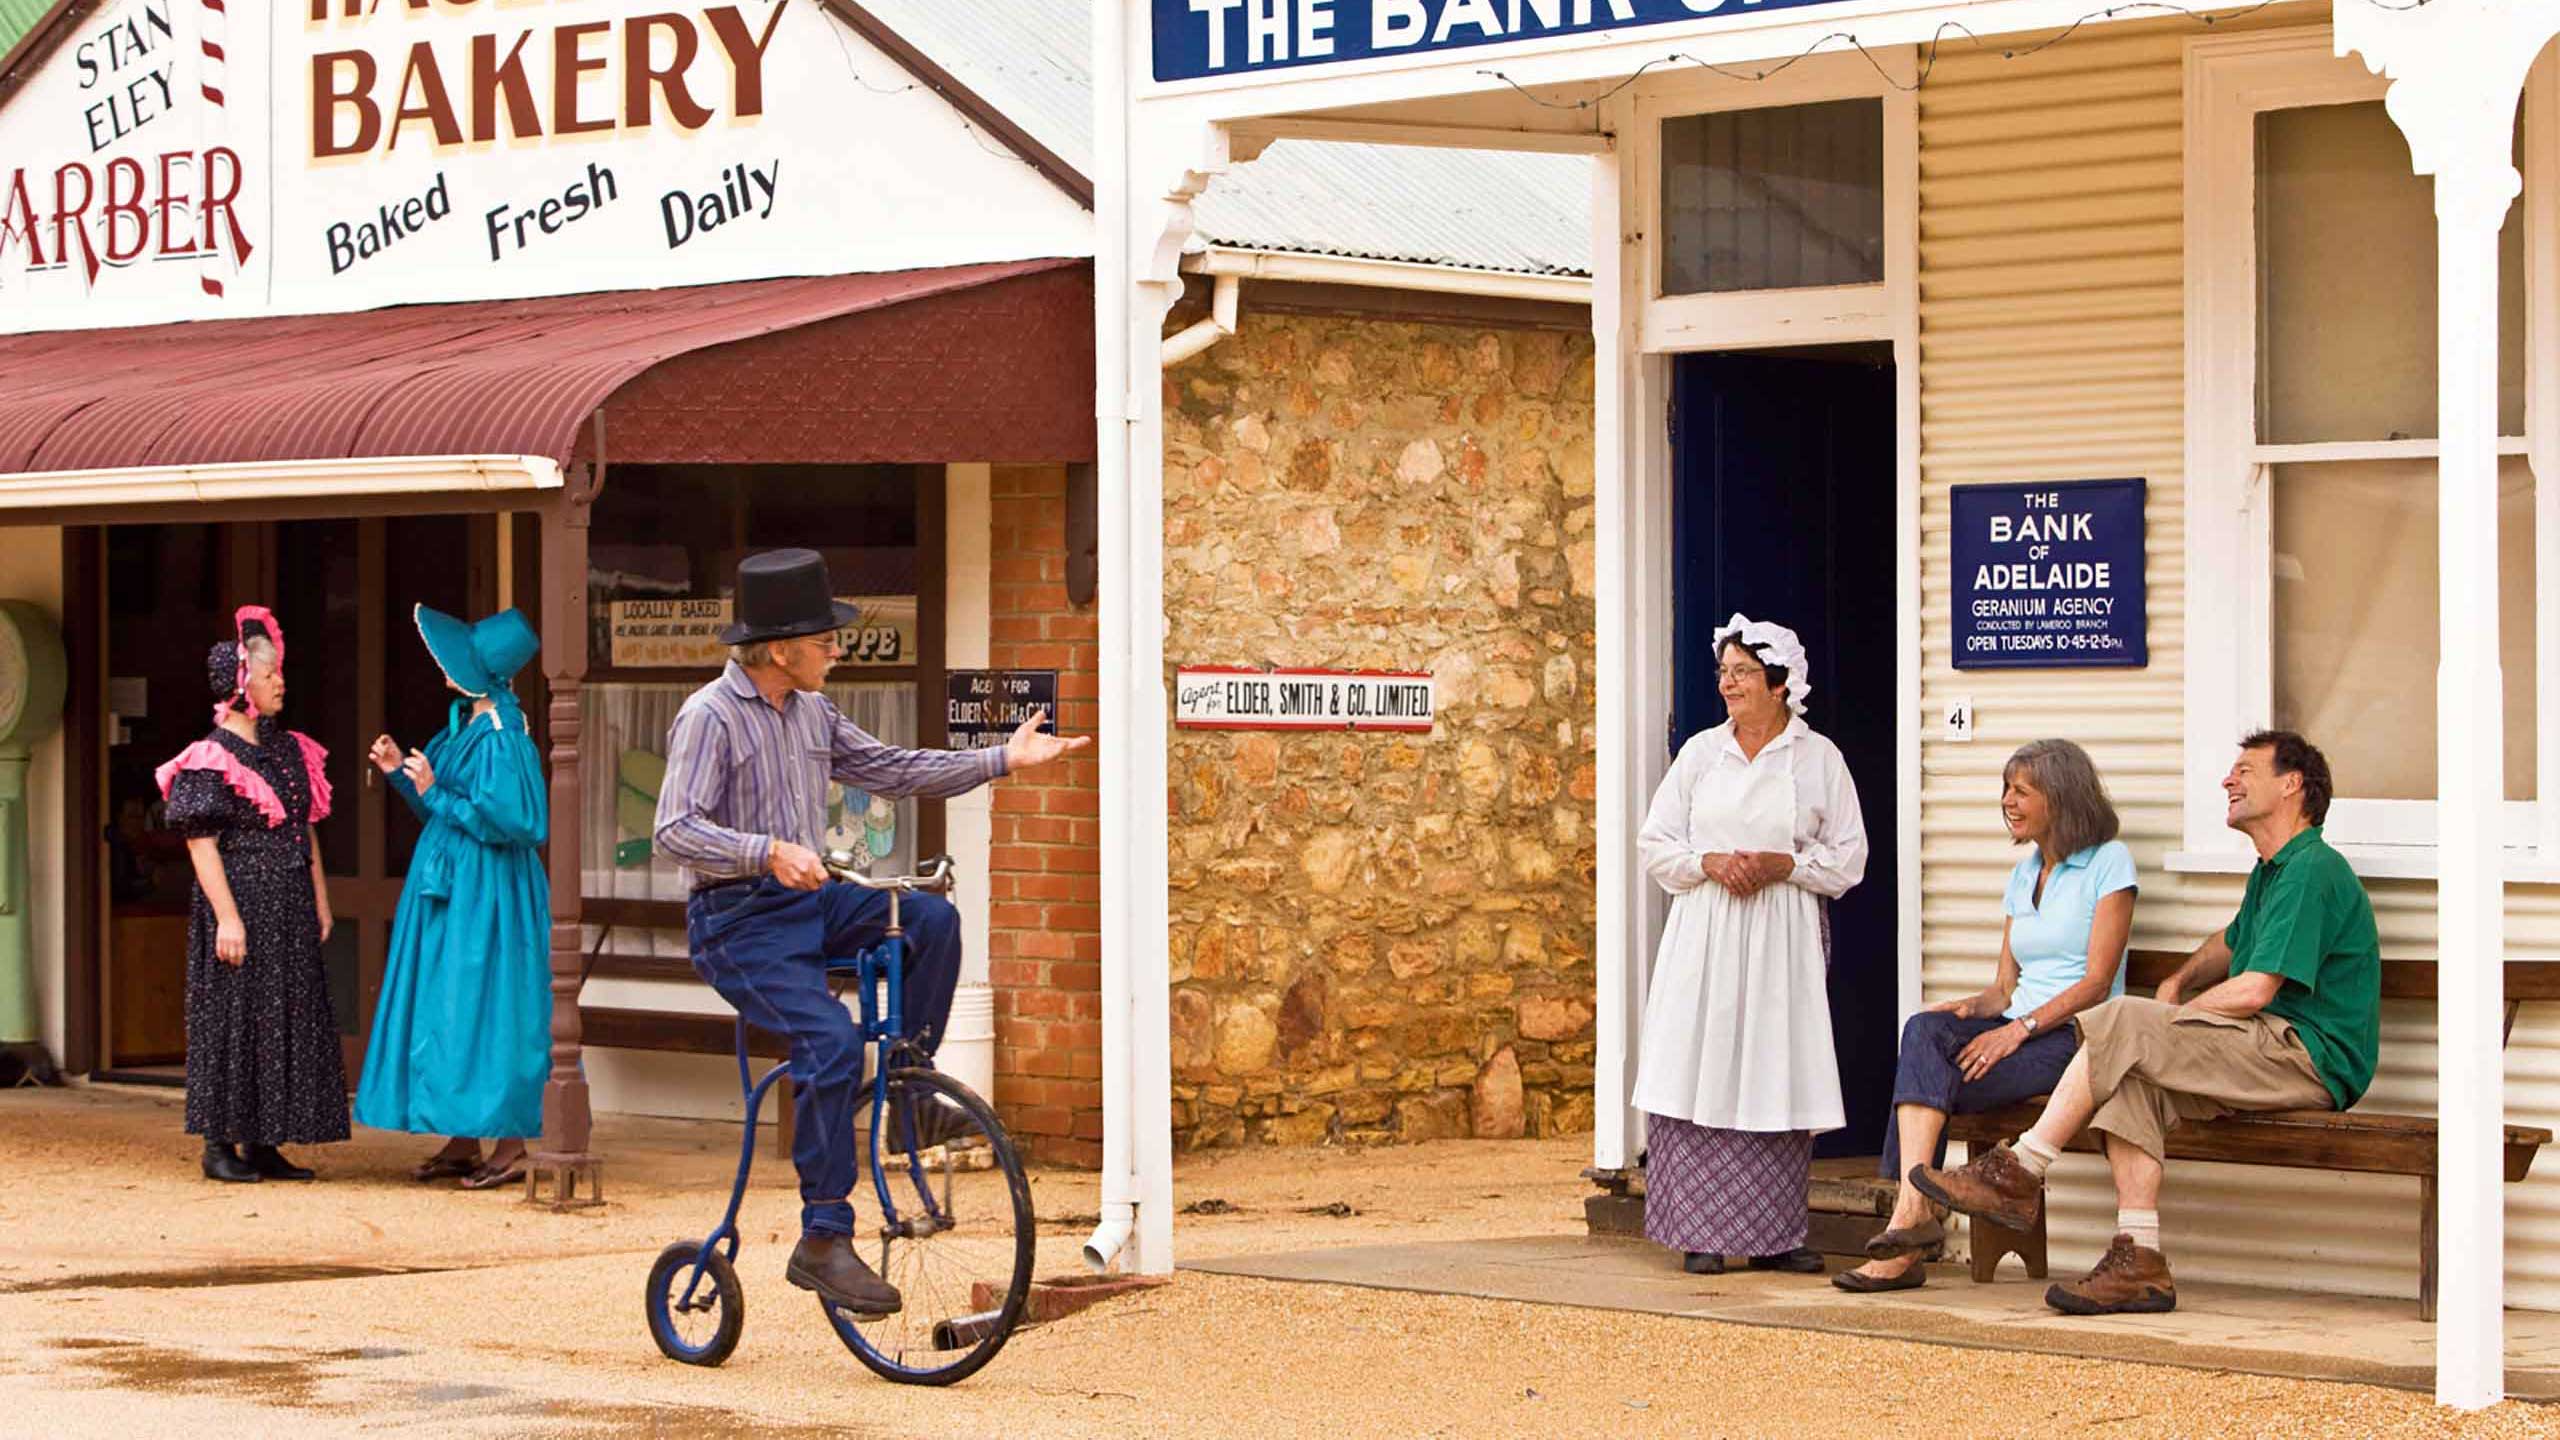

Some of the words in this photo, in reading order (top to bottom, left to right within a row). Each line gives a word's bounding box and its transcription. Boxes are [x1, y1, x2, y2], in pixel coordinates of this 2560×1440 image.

[76, 0, 173, 89] STAN
[1189, 0, 1334, 69] THE
[1372, 0, 1636, 49] BA
[312, 0, 788, 158] BAKERY
[84, 61, 173, 152] ELEY
[0, 146, 254, 287] ARBER
[327, 173, 451, 275] Baked
[485, 163, 617, 262] Fresh
[660, 159, 779, 250] Daily
[2023, 492, 2059, 509] THE
[1990, 513, 2093, 543] BANK
[2028, 545, 2050, 561] OF
[1973, 562, 2110, 590] ADELAIDE
[623, 602, 672, 619] LOCALLY
[680, 601, 721, 618] BAKED
[1971, 598, 2046, 617] GERANIUM
[2053, 597, 2114, 616] AGENCY
[1976, 620, 2022, 631] CONDUCTED
[2024, 620, 2035, 630] BY
[2075, 618, 2109, 630] BRANCH
[837, 625, 901, 661] PPE
[1966, 635, 1998, 652] OPEN
[2001, 634, 2054, 651] TUESDAYS
[948, 699, 981, 723] ELDER
[983, 699, 1018, 724] SITH
[1226, 681, 1274, 716] ELDER,
[1279, 682, 1323, 716] SMITH
[1329, 683, 1340, 716] &
[1949, 708, 1965, 730] 4
